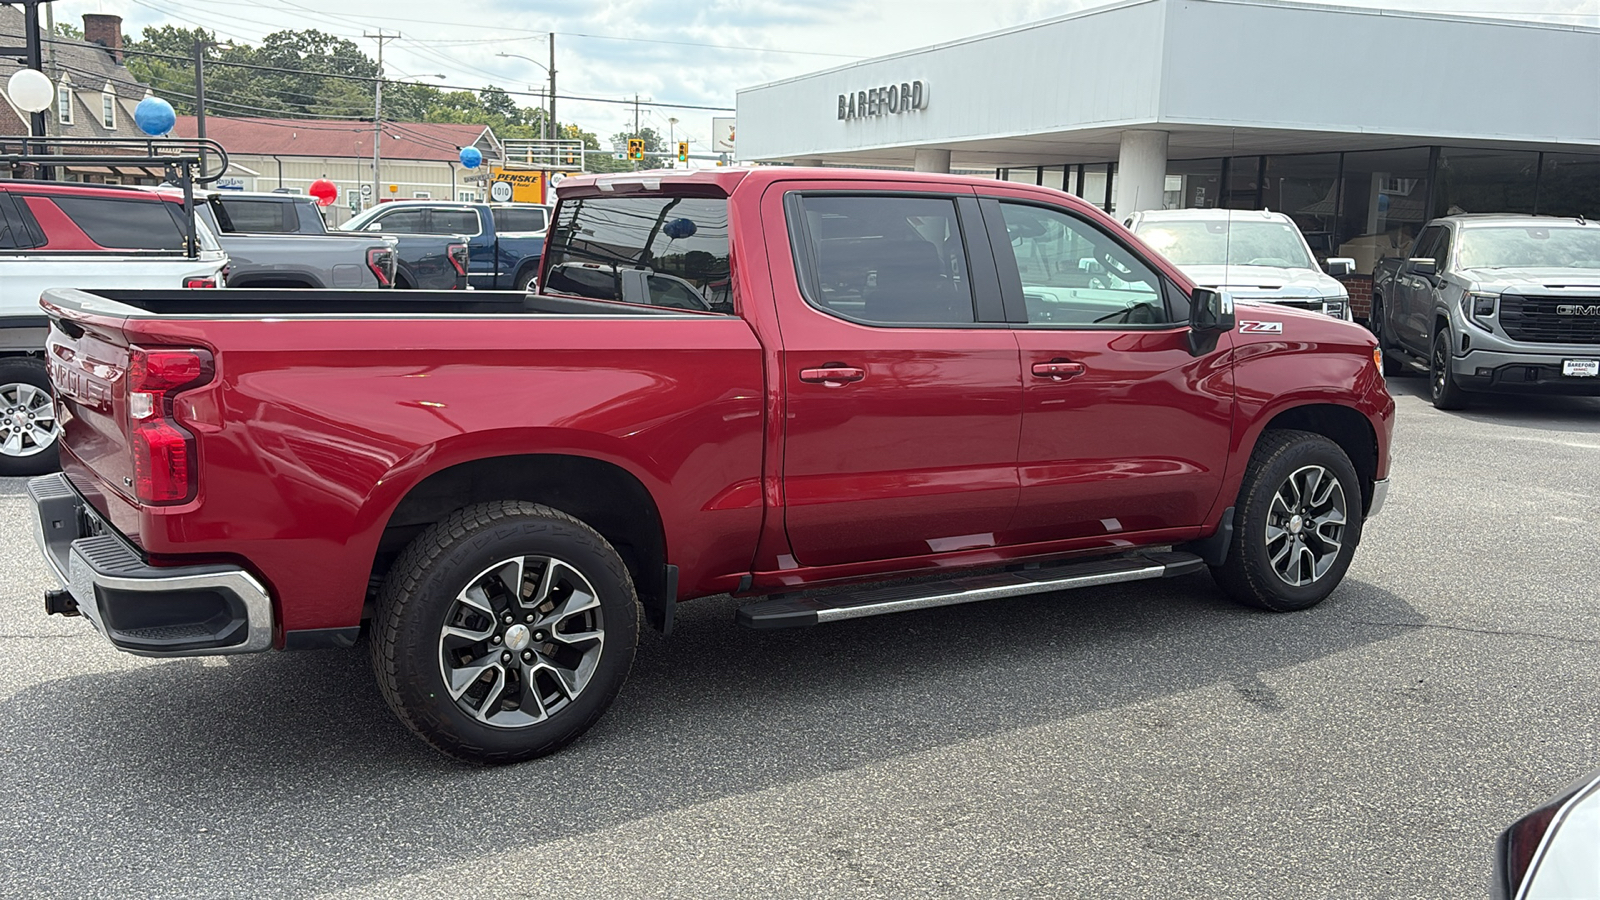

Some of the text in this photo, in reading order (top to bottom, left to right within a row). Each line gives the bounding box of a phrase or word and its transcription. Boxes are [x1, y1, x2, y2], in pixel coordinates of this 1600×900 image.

[838, 80, 925, 120] BAREFORD
[497, 173, 539, 183] PENSKE
[493, 187, 509, 196] 1010
